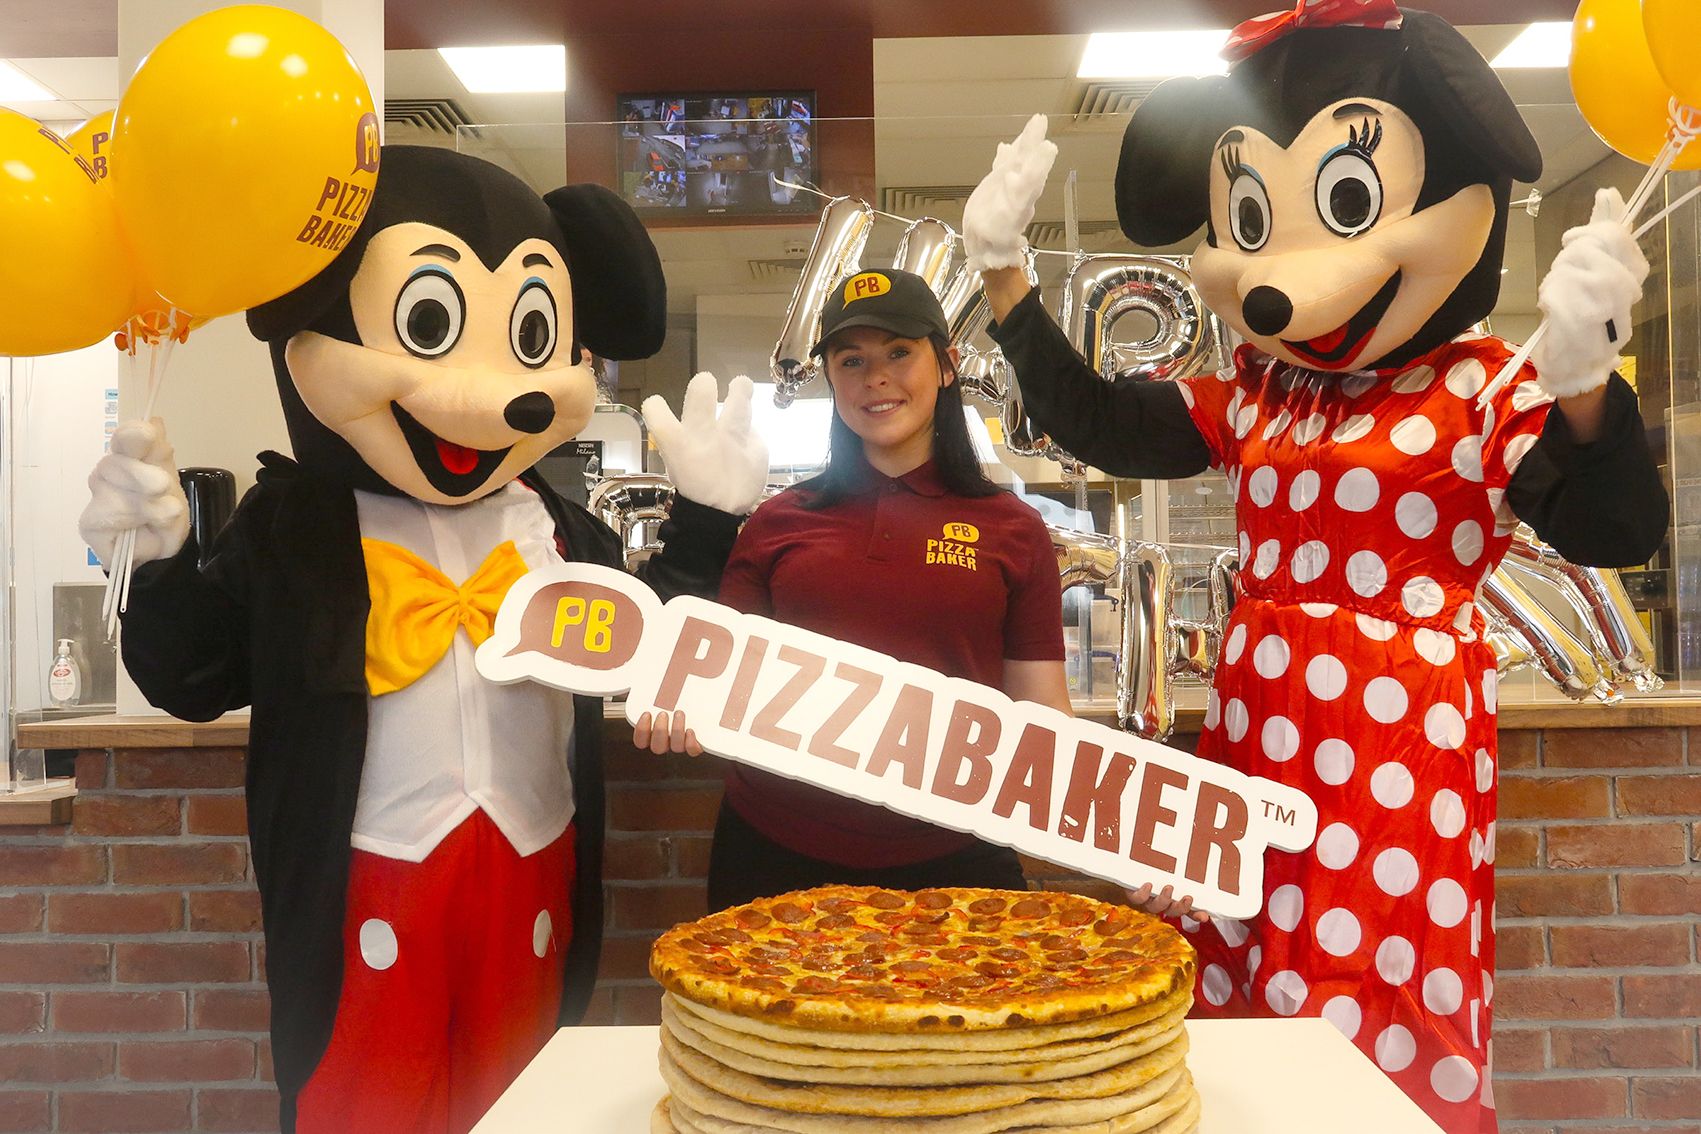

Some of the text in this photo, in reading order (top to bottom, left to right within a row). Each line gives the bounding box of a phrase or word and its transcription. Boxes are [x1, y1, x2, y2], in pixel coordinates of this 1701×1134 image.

[855, 277, 880, 296] PB
[952, 525, 971, 538] PB
[927, 539, 976, 557] PIZZA
[926, 551, 977, 571] BAKER
[550, 596, 616, 653] PB
[653, 615, 1249, 896] PIZZABAKER
